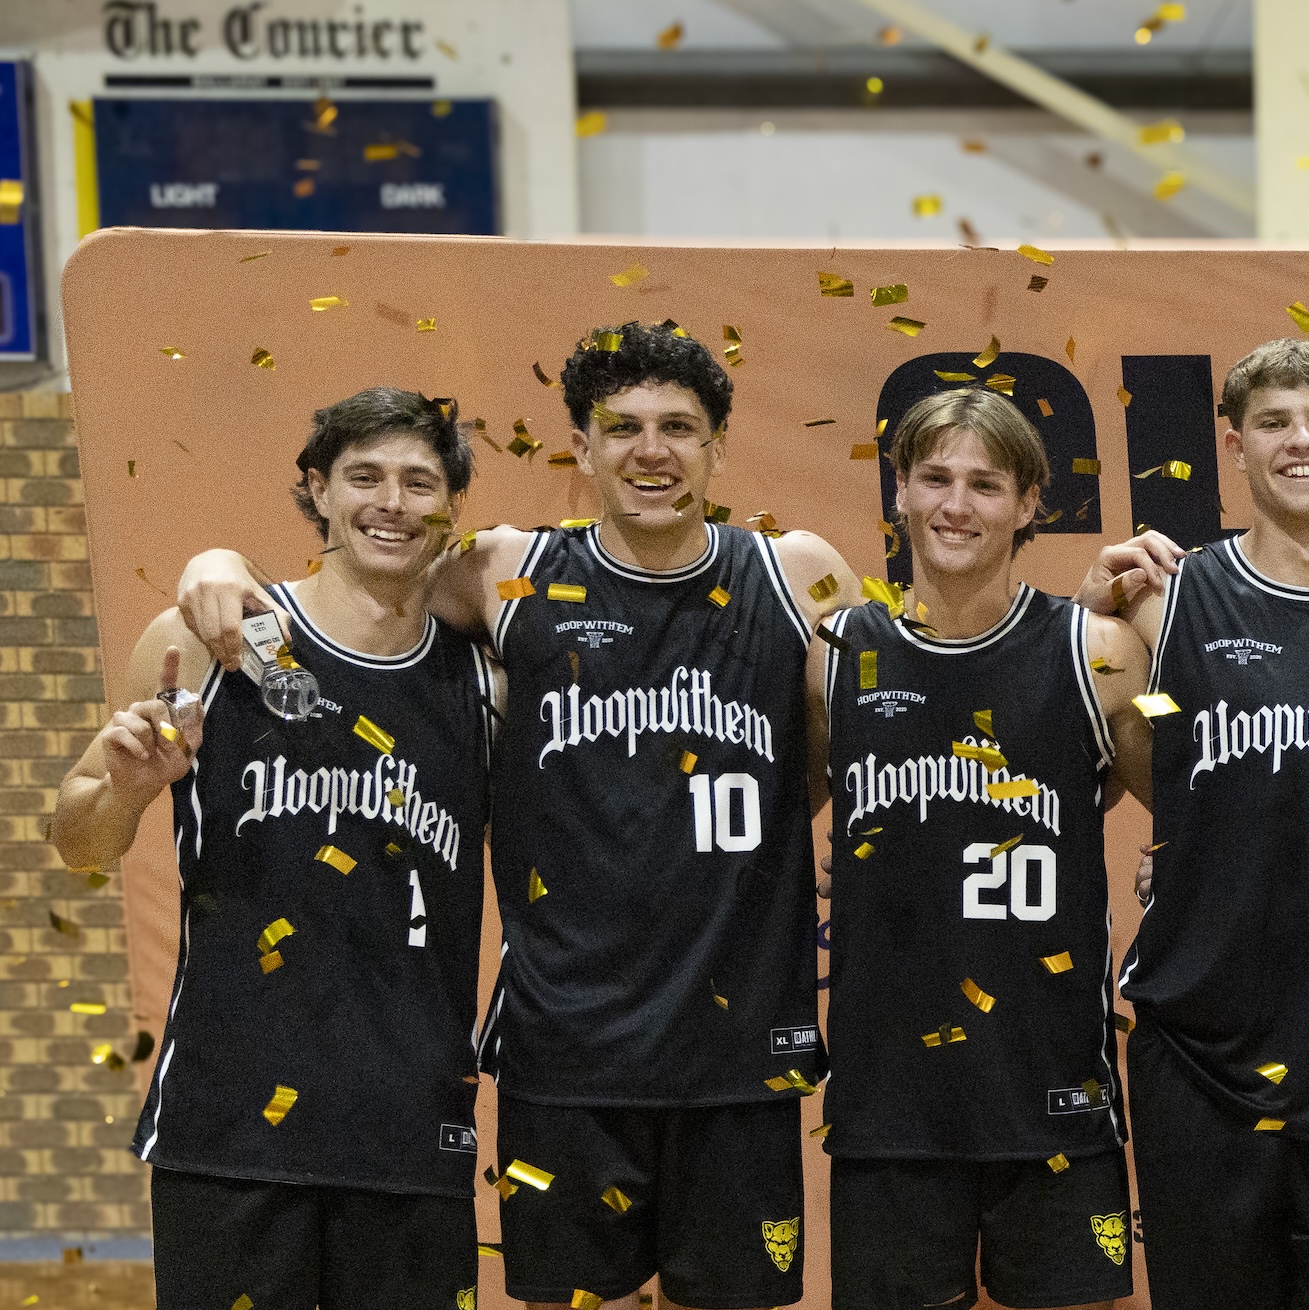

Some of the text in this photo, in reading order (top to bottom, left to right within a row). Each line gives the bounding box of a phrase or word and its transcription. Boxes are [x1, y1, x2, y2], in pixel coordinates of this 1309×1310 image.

[105, 1, 426, 60] The Courier
[151, 183, 218, 207] LIGHT
[381, 184, 444, 208] DARK
[689, 771, 762, 853] 10
[962, 842, 1058, 921] 20
[776, 1037, 789, 1045] XL
[1059, 1098, 1066, 1106] L
